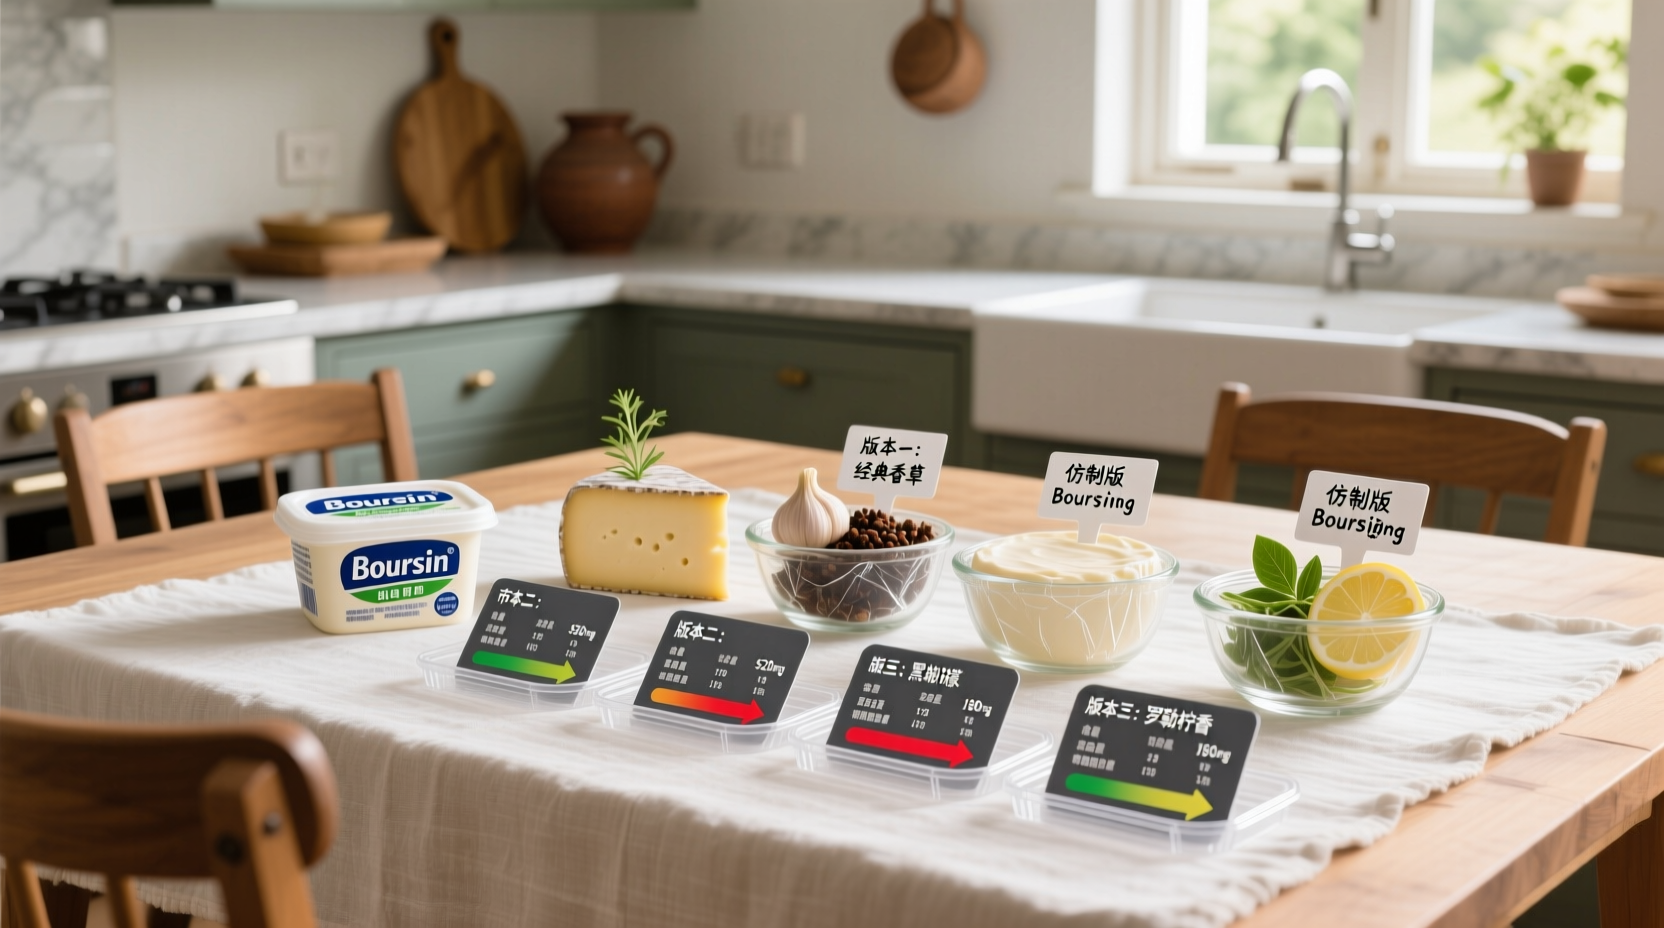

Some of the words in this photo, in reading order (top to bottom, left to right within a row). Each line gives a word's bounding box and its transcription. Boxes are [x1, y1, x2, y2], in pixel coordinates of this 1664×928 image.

[853, 461, 926, 487] 经典香草
[1065, 463, 1126, 488] 仿制版
[1326, 484, 1393, 514] 仿制版
[351, 549, 448, 581] Boursin
